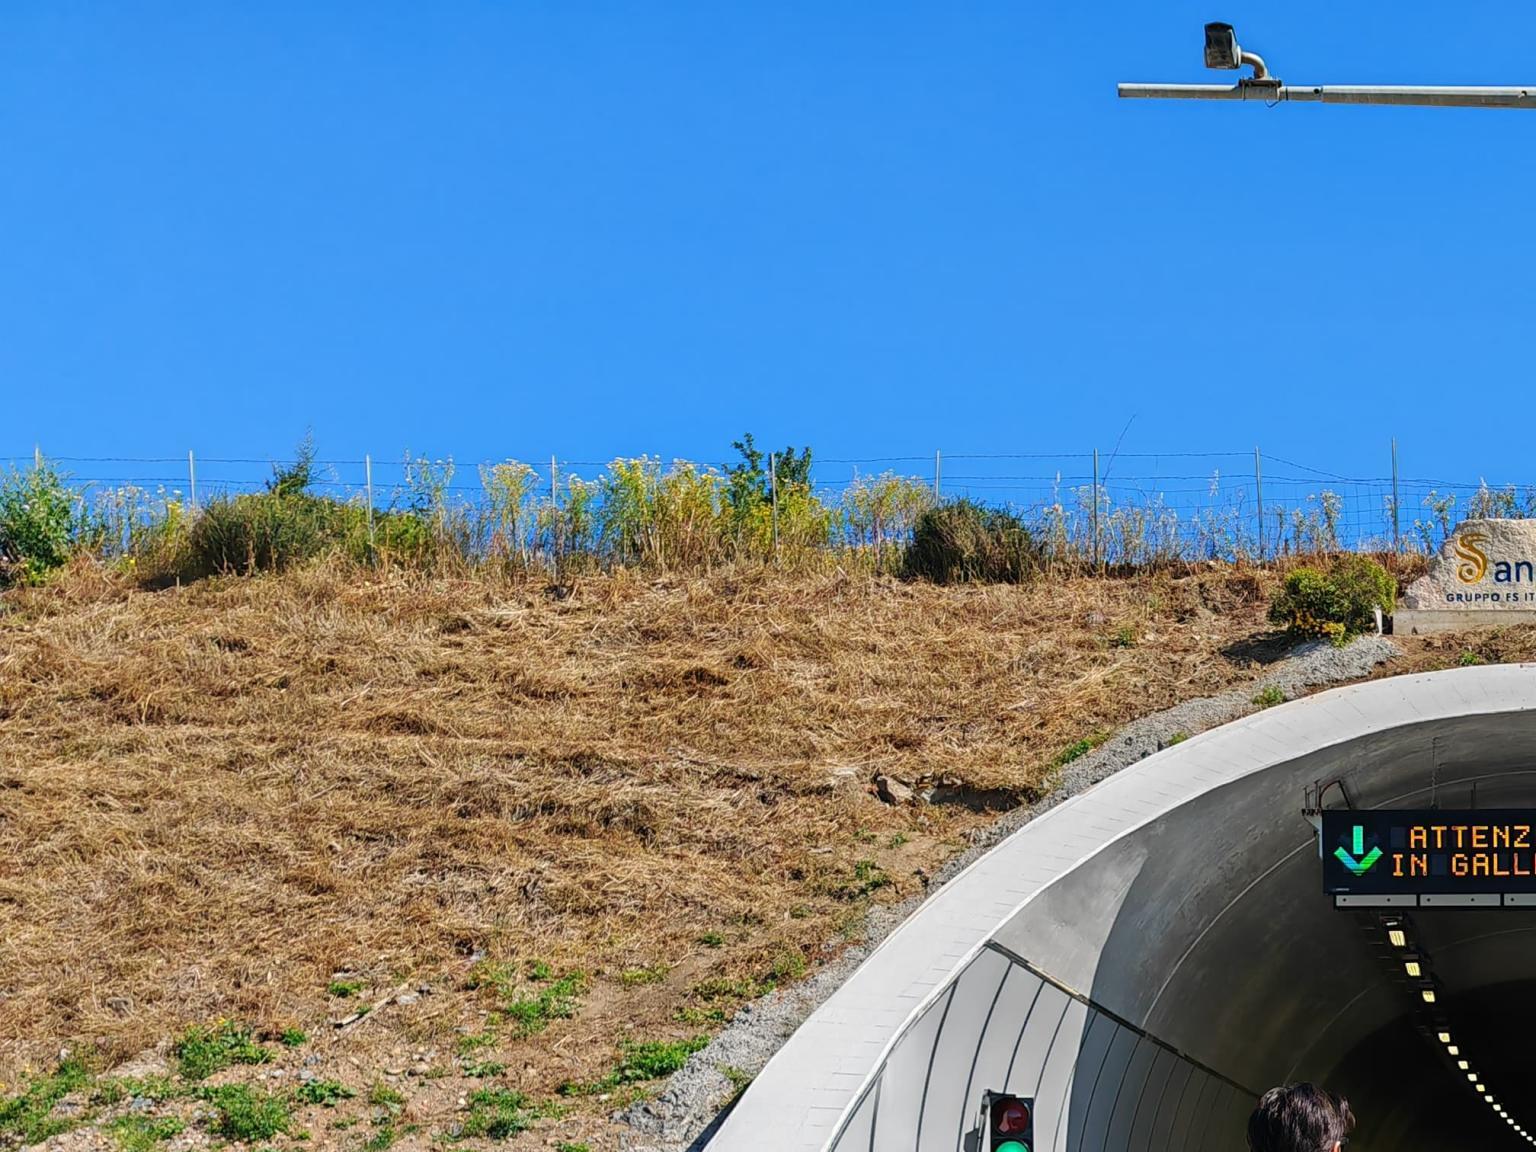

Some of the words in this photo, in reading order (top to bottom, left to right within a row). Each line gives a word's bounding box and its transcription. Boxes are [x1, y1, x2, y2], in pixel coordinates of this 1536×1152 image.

[1446, 592, 1500, 603] GRUPPO
[1506, 592, 1519, 602] FS
[1392, 853, 1429, 877] IN
